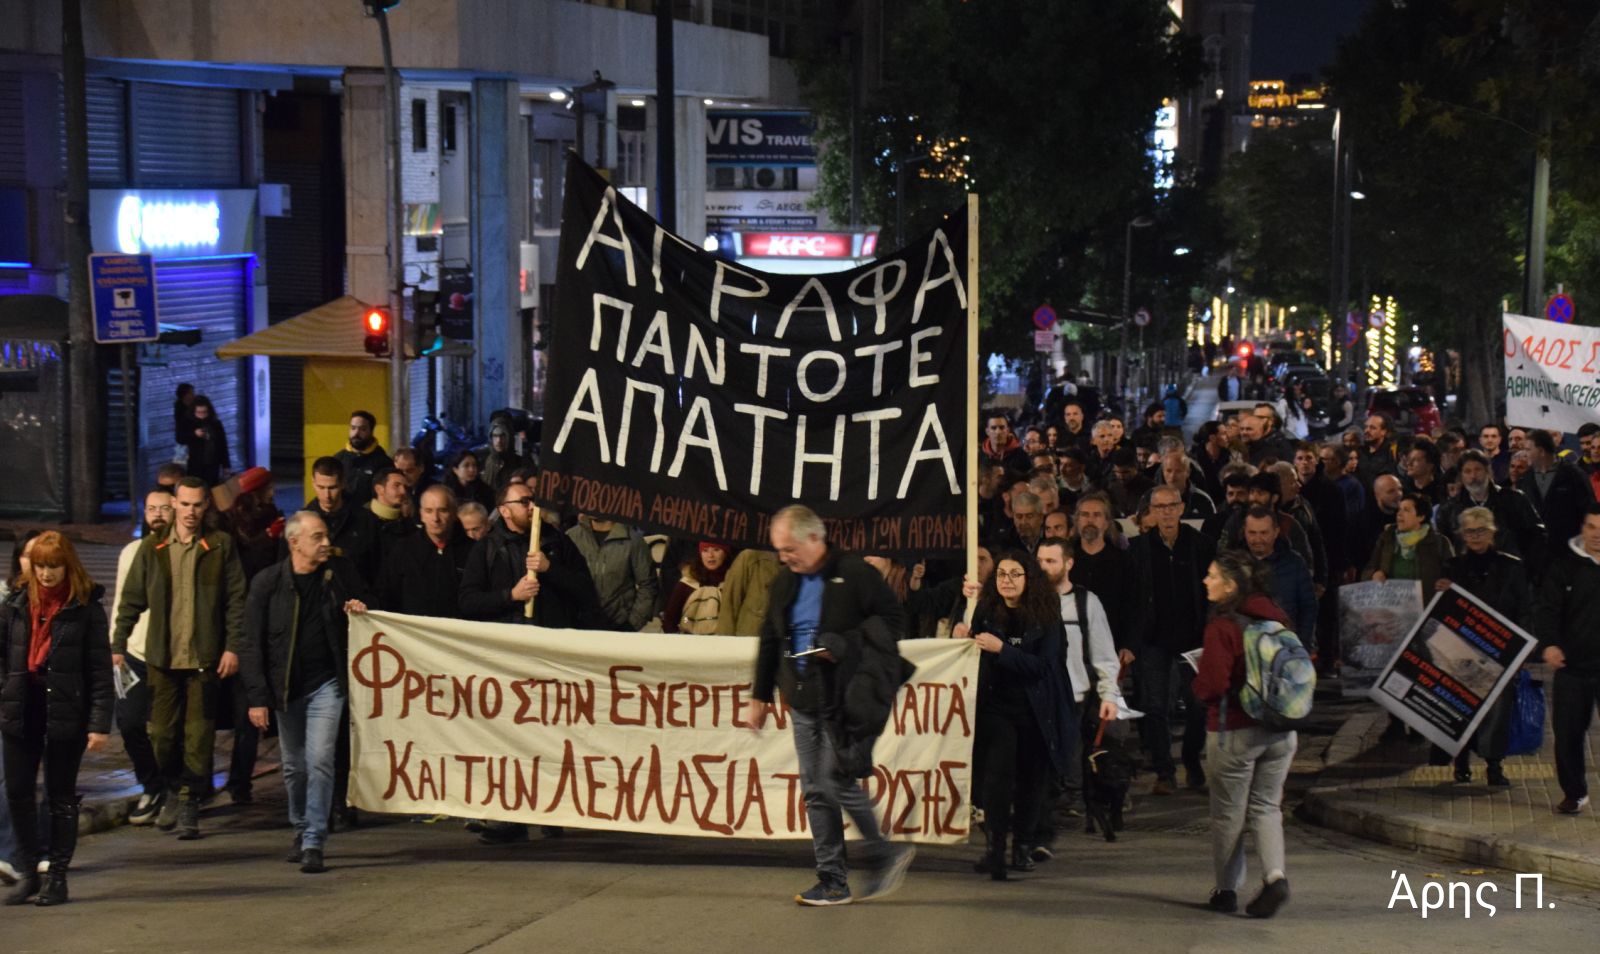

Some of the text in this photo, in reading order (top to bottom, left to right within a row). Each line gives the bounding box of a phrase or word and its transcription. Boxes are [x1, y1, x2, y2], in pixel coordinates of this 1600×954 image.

[576, 185, 968, 340] ΑΓΡΑΦΑ
[767, 235, 825, 256] KFC
[590, 293, 943, 402] ΠΑΝΤΟΤΕ
[1521, 335, 1581, 370] ΛΑΟΣ
[553, 368, 962, 501] ΑΠΑΤΗΤΑ
[650, 493, 721, 539] ΑΘΗΝΑΣ
[722, 508, 748, 541] ΓΙΑ
[352, 632, 502, 719] ΦΡΕΝΟ
[513, 677, 596, 726] ΣΤΗΝ
[383, 740, 446, 802] ΚΑΙ
[454, 754, 541, 812] ΤΗΝ
[545, 739, 774, 837] ΛΕΗΛΑΣΙΑ
